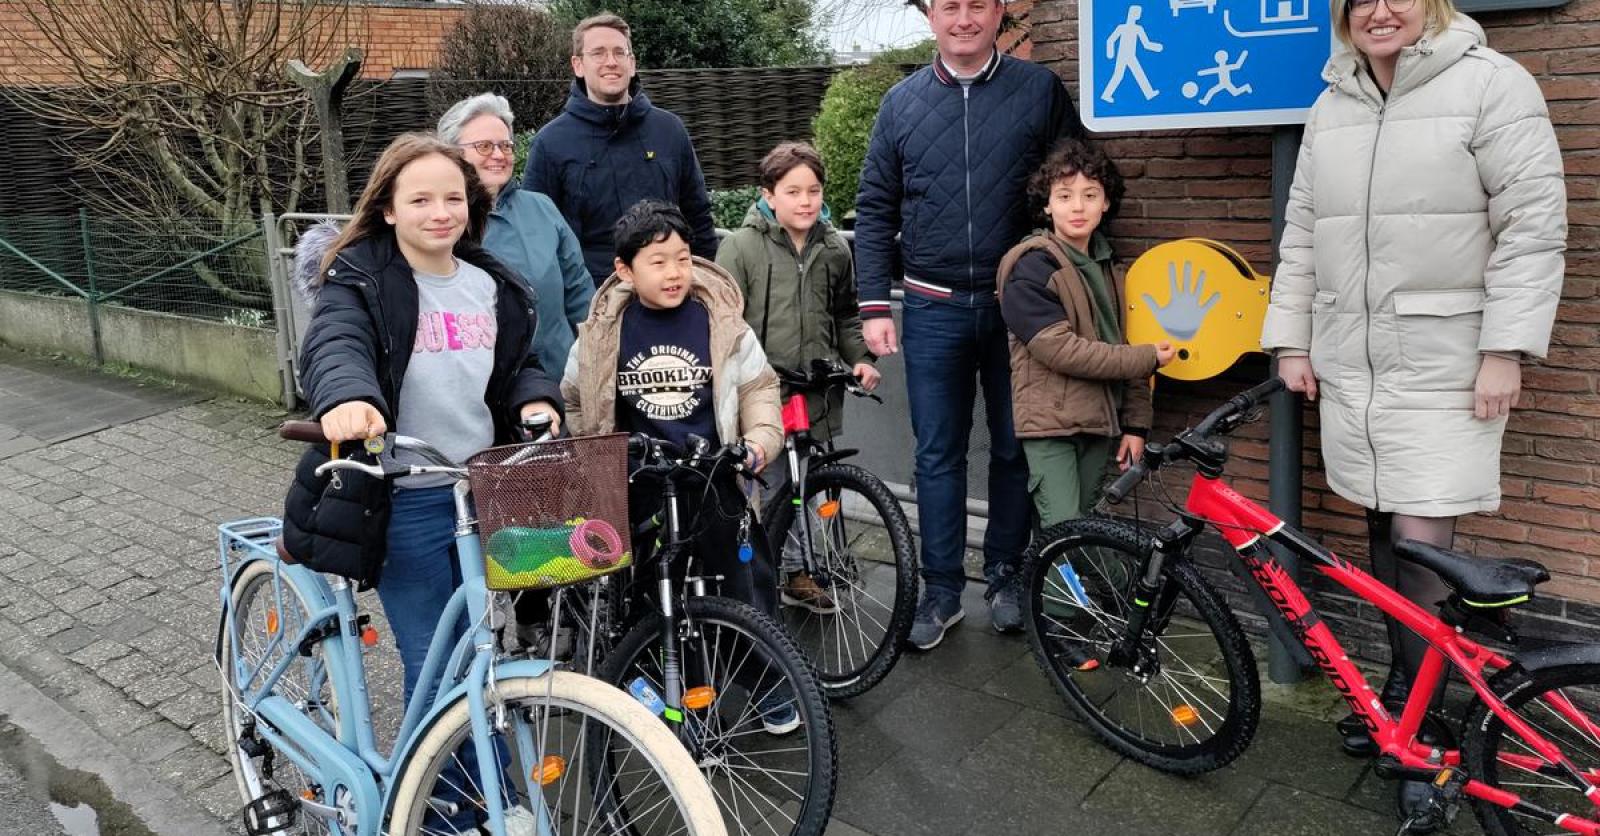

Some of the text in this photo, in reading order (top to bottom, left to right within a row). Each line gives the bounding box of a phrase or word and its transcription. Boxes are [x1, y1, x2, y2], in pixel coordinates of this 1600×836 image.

[626, 345, 700, 369] THE ORIGINAL
[618, 368, 712, 386] BROOKLYN
[635, 399, 685, 416] CLOTHING
